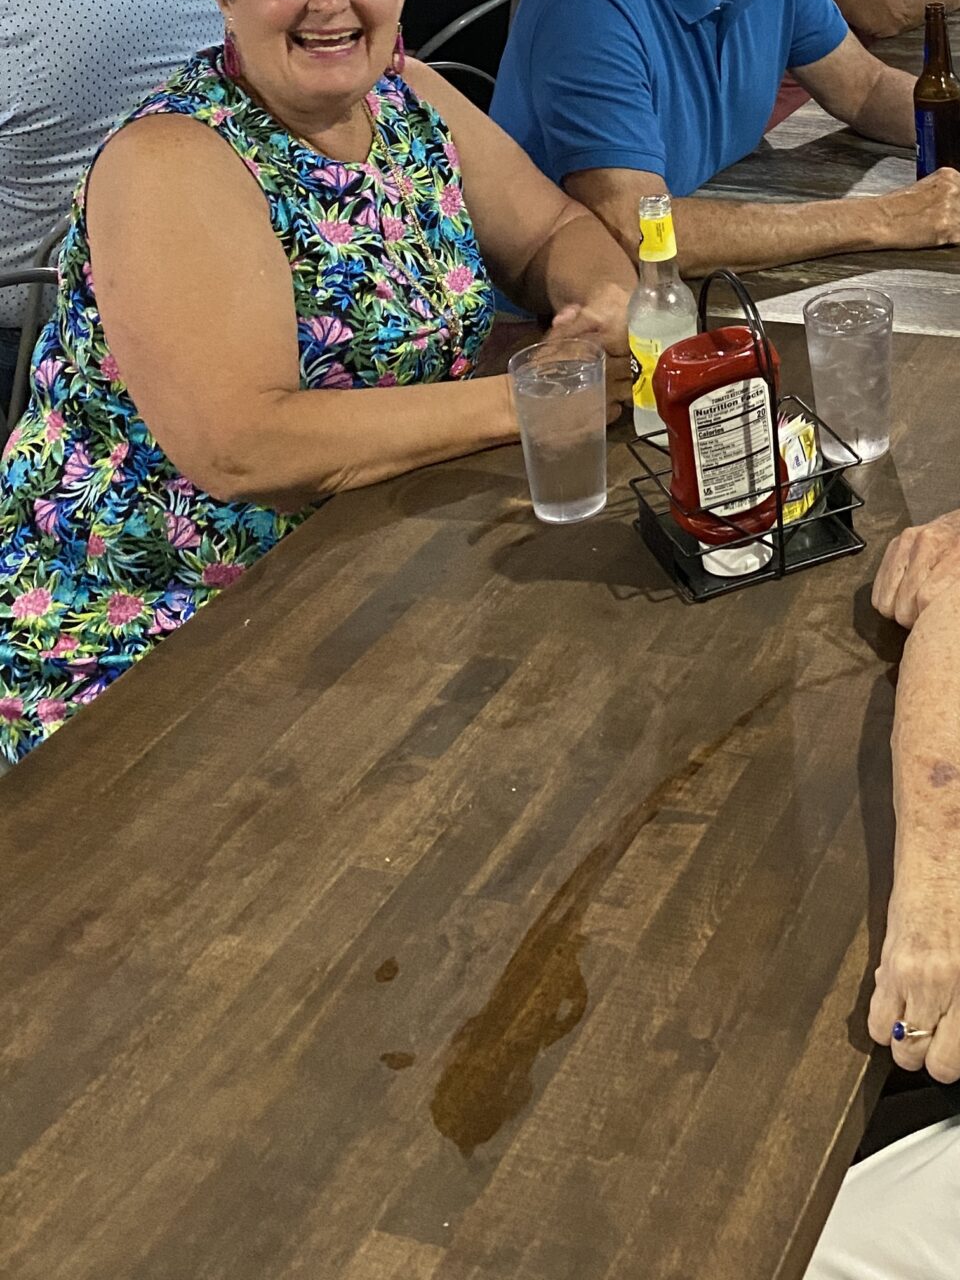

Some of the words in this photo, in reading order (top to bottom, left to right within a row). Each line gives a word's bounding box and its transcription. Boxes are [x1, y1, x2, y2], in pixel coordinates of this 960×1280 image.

[695, 400, 739, 416] Nutrition
[740, 389, 764, 403] Facts
[756, 408, 766, 418] 20
[698, 428, 725, 438] Calories
